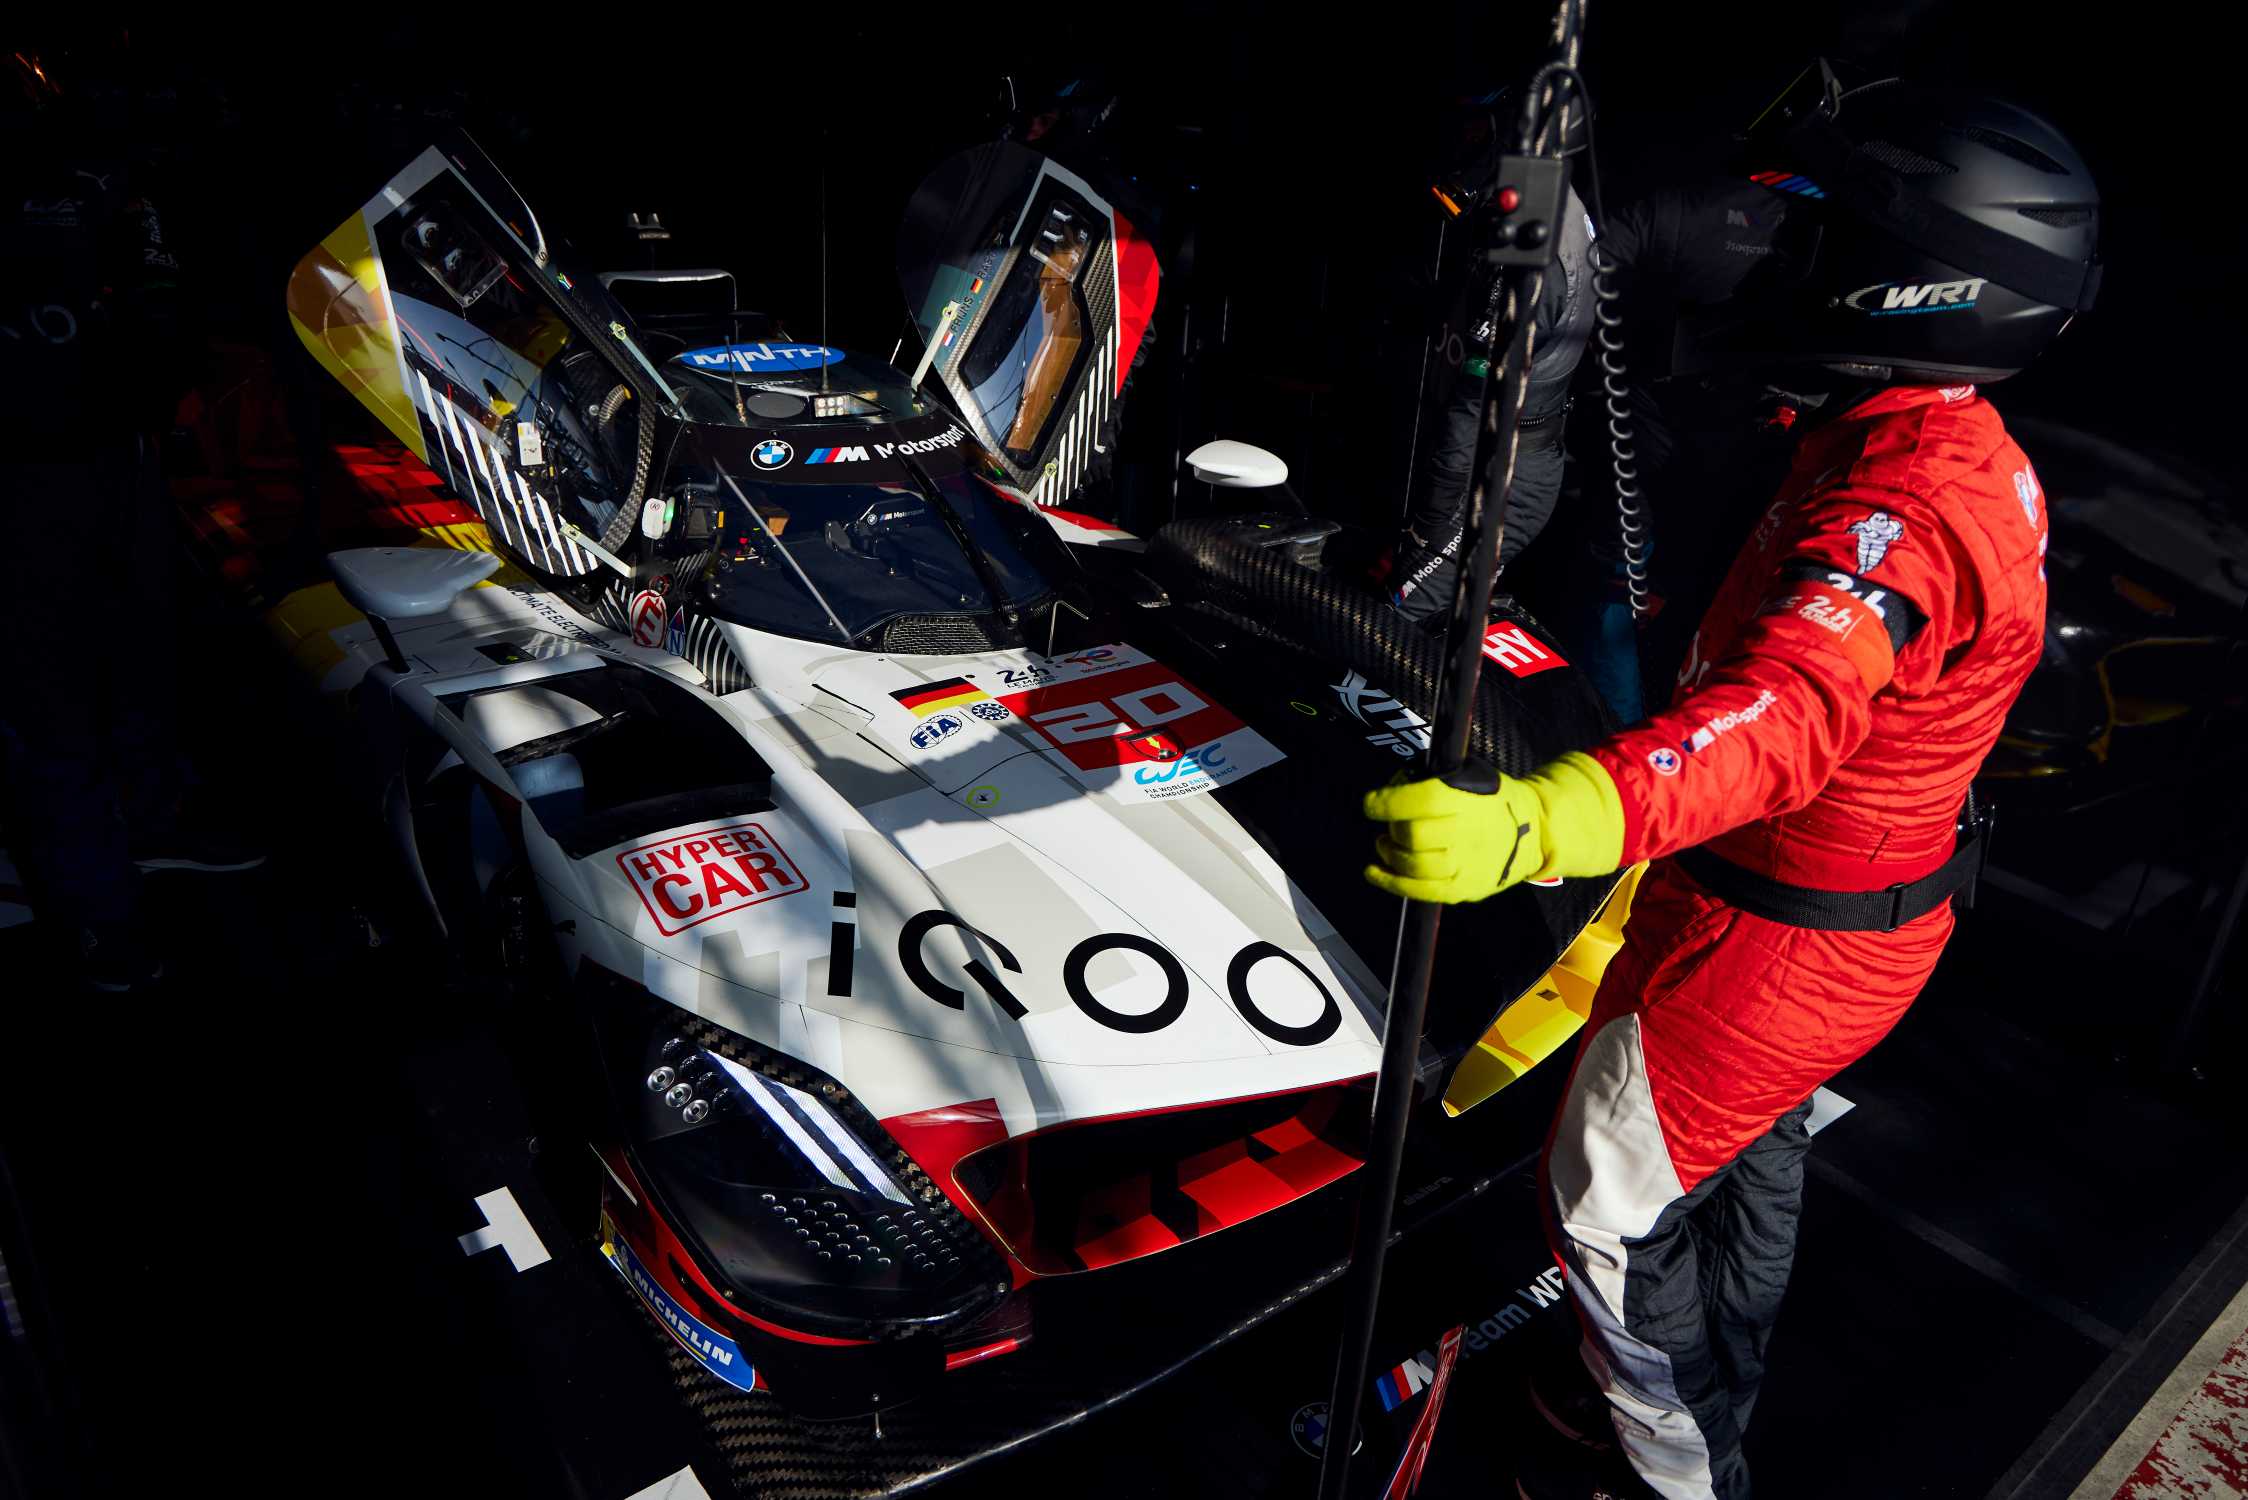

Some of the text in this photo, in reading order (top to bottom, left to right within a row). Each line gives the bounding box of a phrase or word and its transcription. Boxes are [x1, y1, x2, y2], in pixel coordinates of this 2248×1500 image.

[1881, 277, 1989, 310] WRT
[873, 423, 966, 459] Motorsport
[1482, 628, 1549, 669] HY
[1029, 681, 1210, 744] 20
[1149, 782, 1211, 799] CHAMPIONSHIP
[1159, 781, 1189, 793] WORLD
[630, 830, 767, 881] HYPER
[652, 852, 795, 920] CAR
[633, 1267, 733, 1367] MICHELIN
[1463, 1302, 1533, 1361] eam
